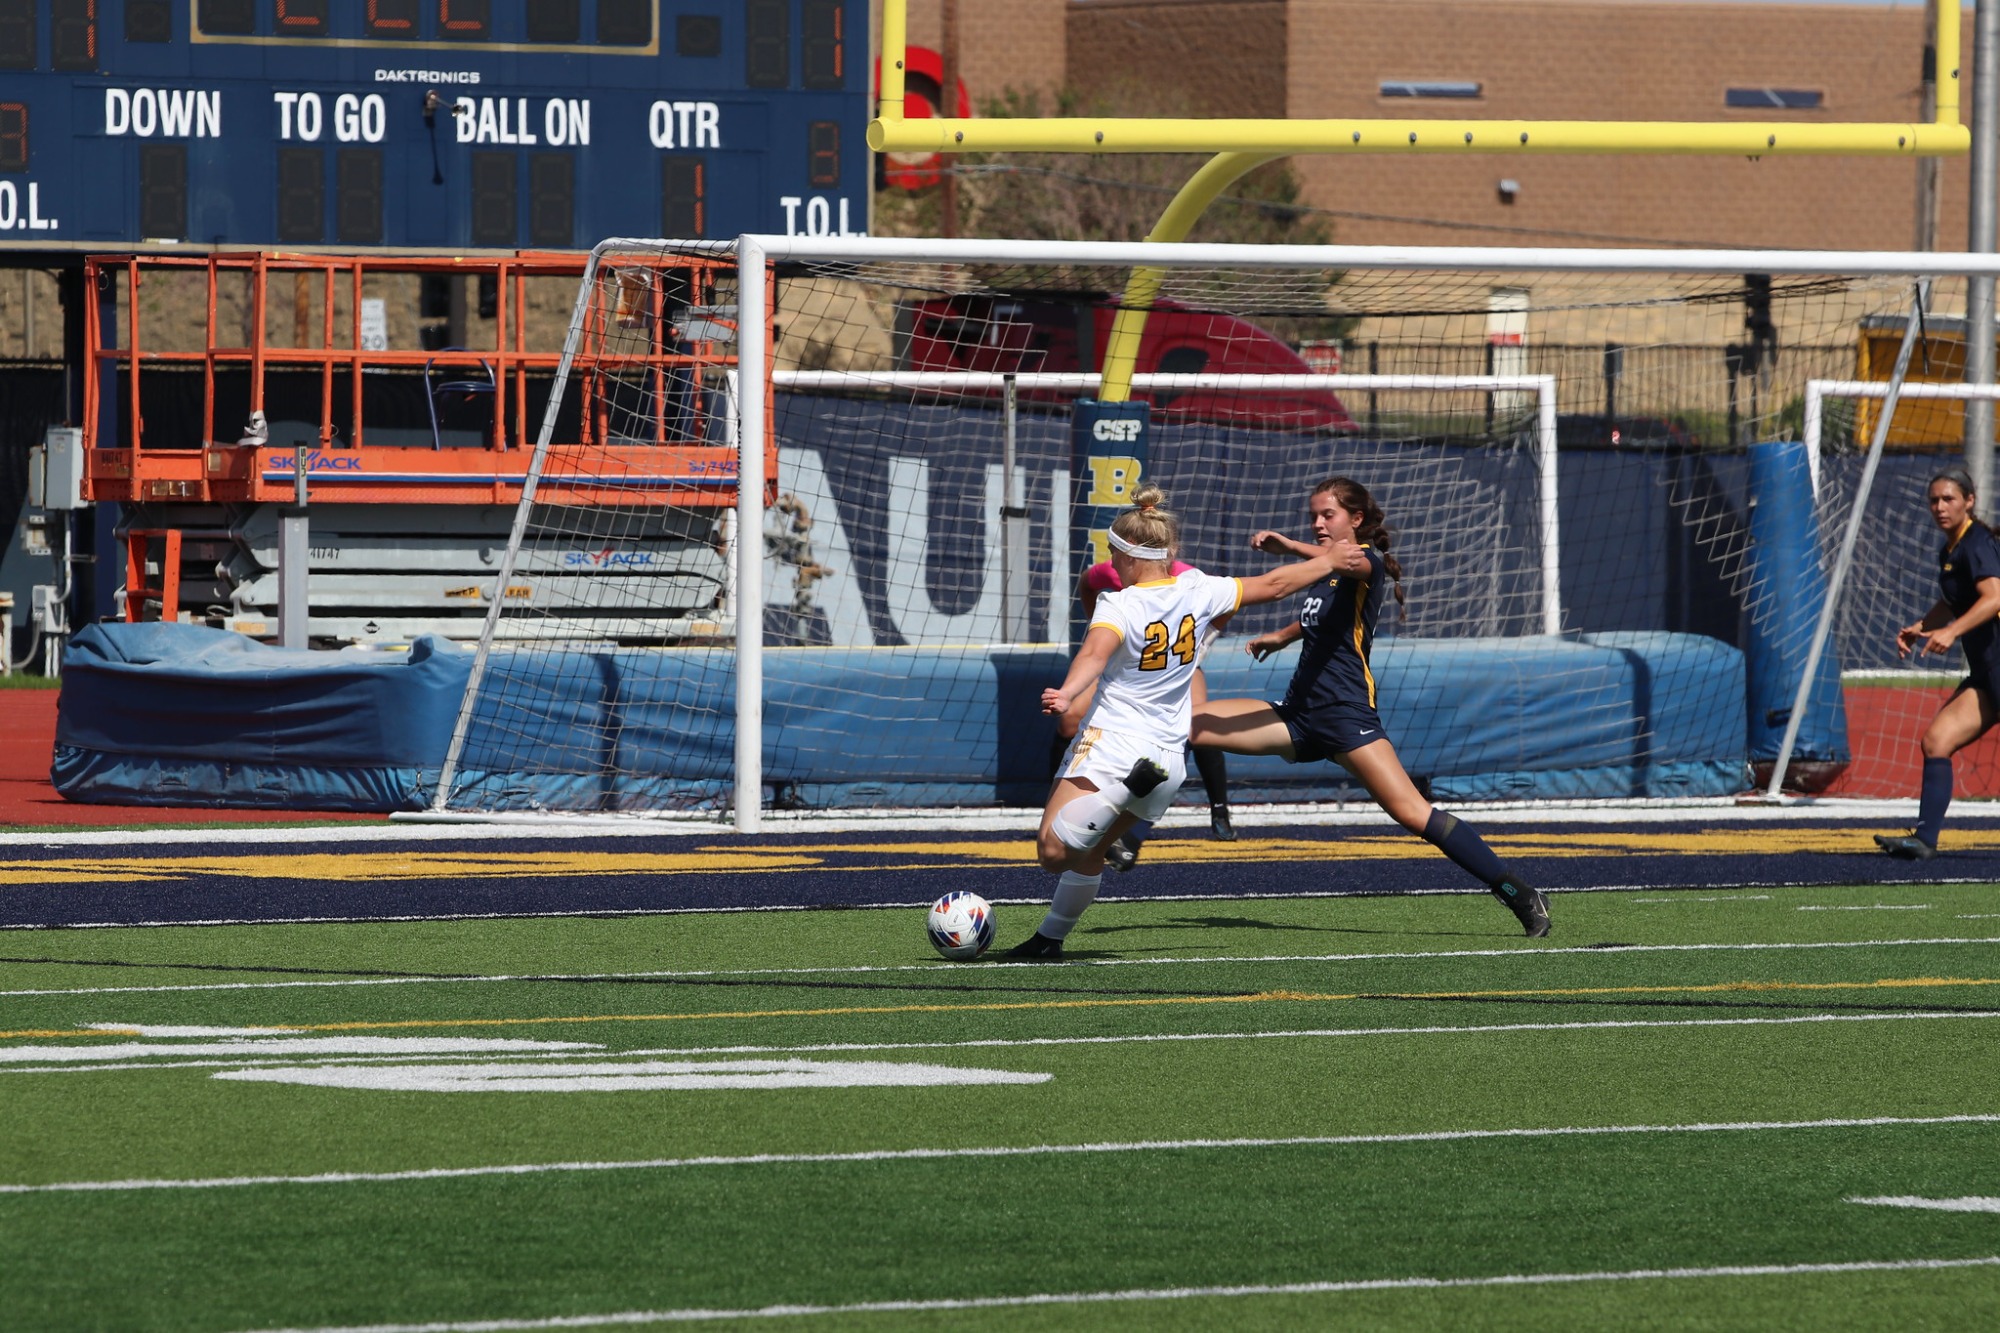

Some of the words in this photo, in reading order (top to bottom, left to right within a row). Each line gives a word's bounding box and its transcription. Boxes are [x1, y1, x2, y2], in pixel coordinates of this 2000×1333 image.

[375, 69, 481, 84] DAKTRONICS
[105, 88, 221, 138] DOWN
[274, 92, 323, 141] TO
[334, 93, 386, 143] GO
[456, 97, 537, 145] BALL
[545, 98, 590, 146] ON
[649, 100, 720, 149] QTR
[780, 196, 868, 237] T.O.L.
[1093, 419, 1142, 442] CSP
[564, 548, 654, 568] SKYJACK
[1301, 596, 1323, 628] 22
[1138, 613, 1197, 672] 24
